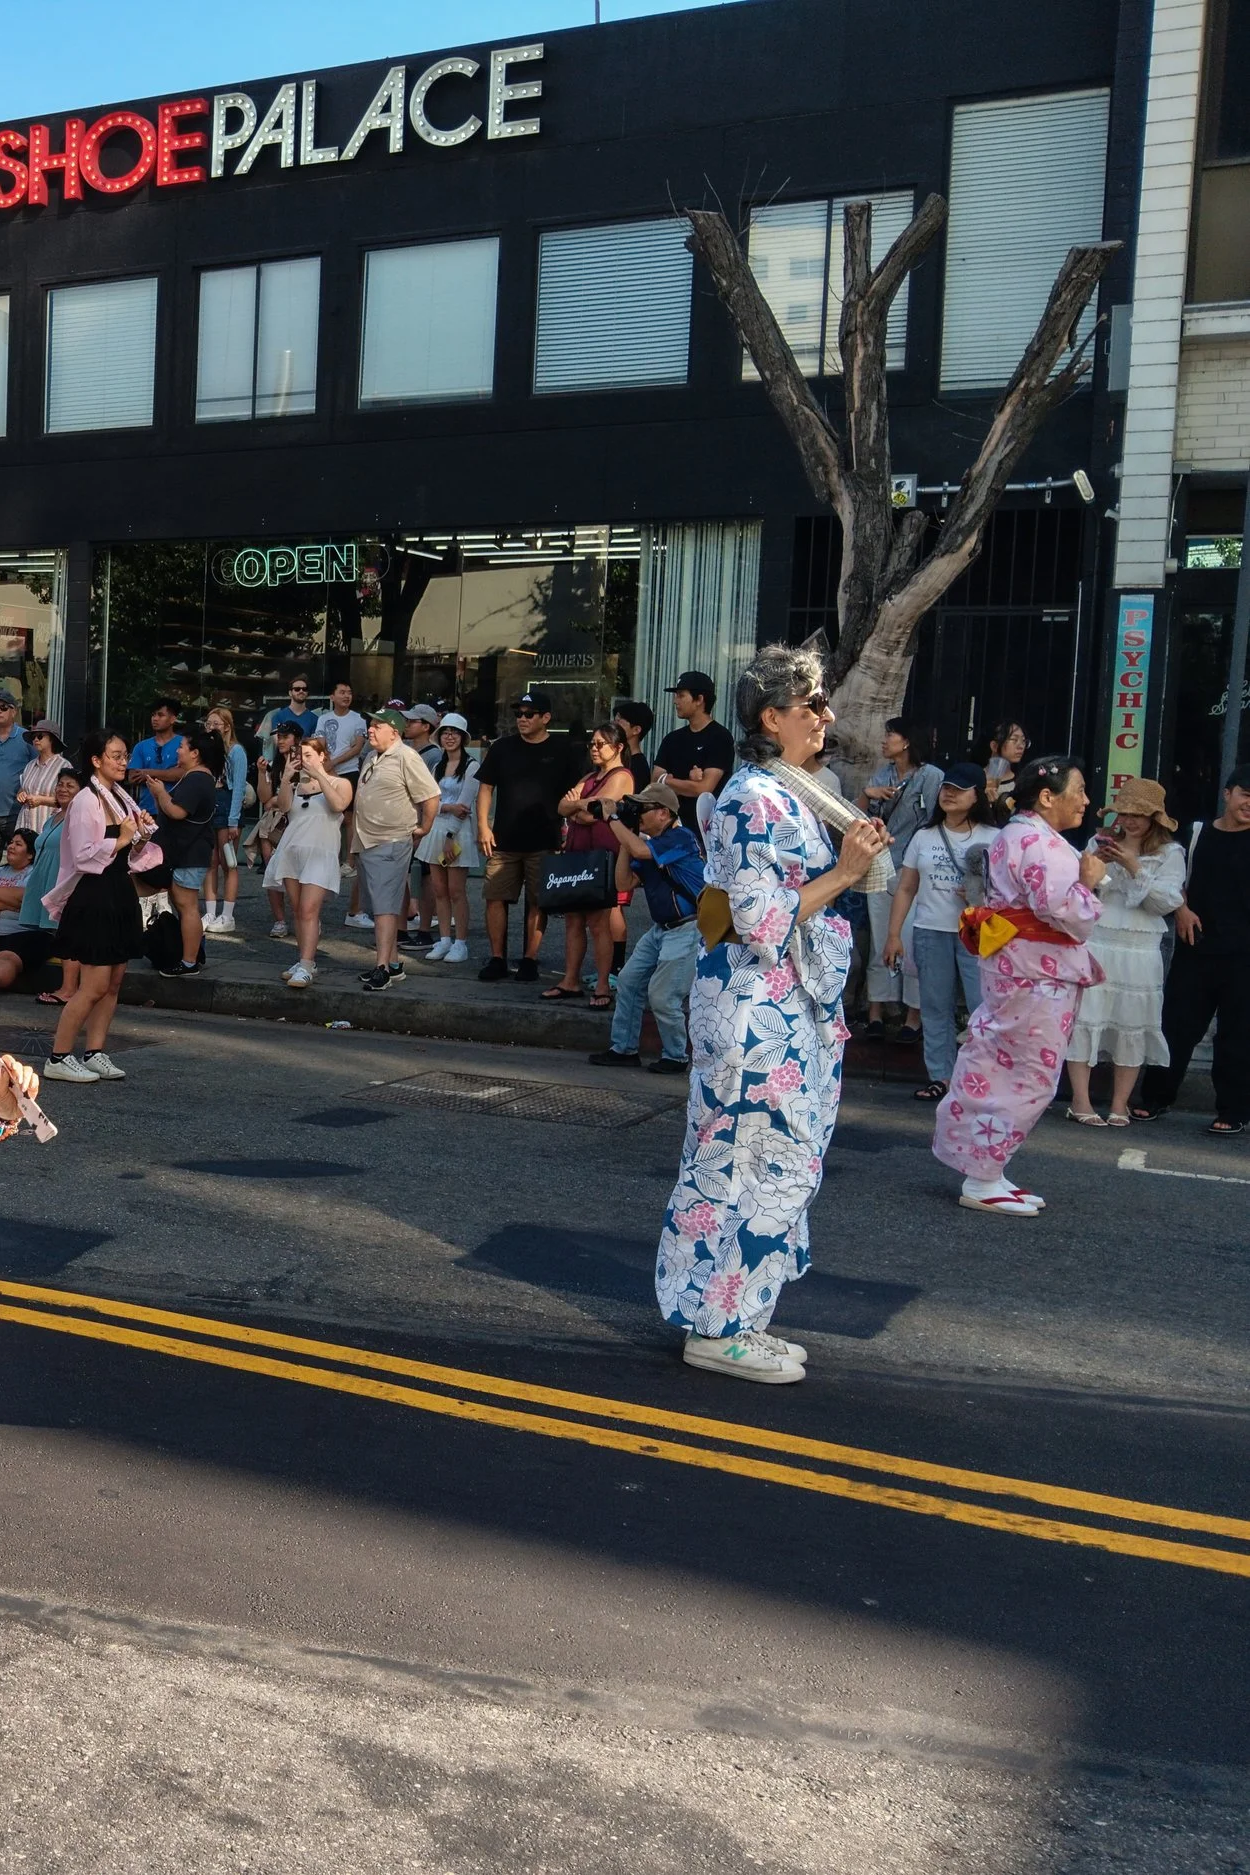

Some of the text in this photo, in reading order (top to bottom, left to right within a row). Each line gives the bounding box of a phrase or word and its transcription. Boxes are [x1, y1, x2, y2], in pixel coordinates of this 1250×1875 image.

[210, 42, 545, 179] PALACE
[234, 543, 356, 588] OPEN
[533, 653, 595, 668] WOMENS
[1115, 609, 1148, 749] PSYCHIC
[546, 869, 595, 890] Japangeles
[928, 873, 961, 881] SPLASH
